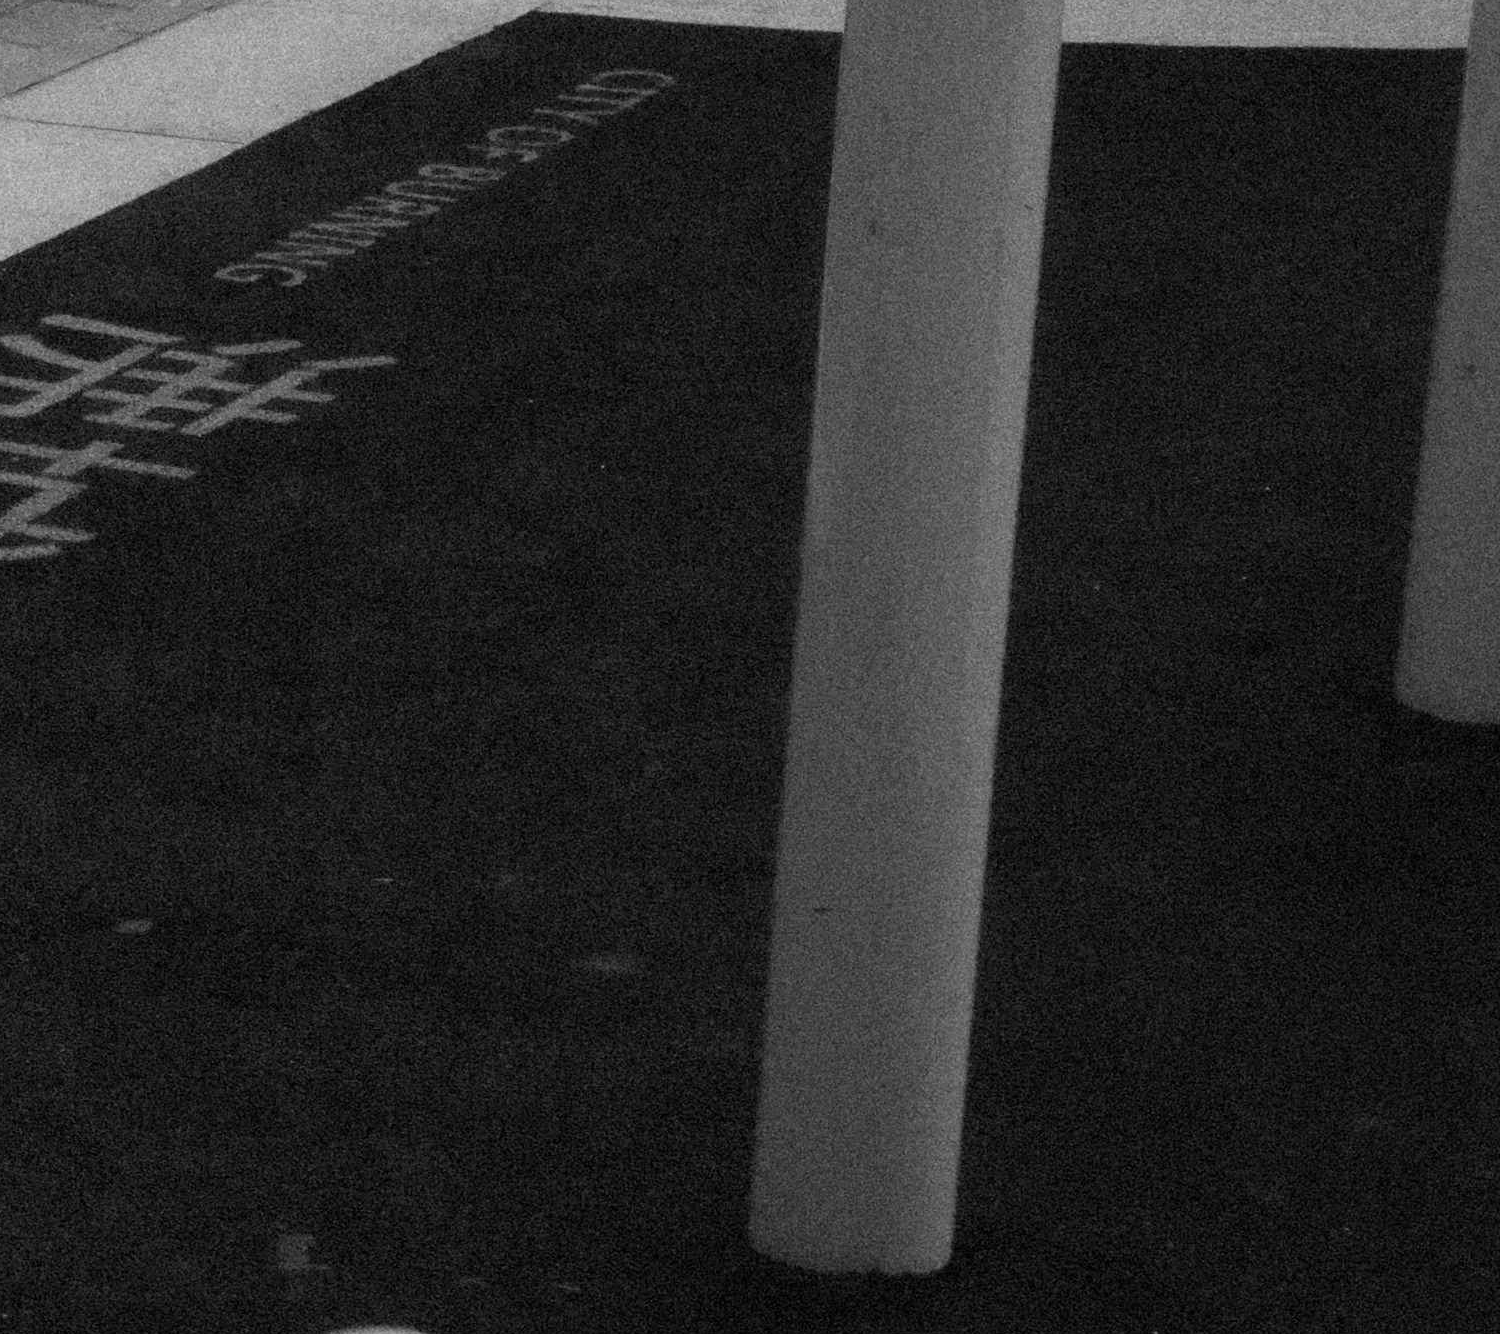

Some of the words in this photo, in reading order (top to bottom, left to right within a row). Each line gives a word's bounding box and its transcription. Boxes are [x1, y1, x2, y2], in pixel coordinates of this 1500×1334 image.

[534, 70, 675, 125] CITY
[464, 125, 574, 163] OF
[214, 163, 507, 287] BURNING
